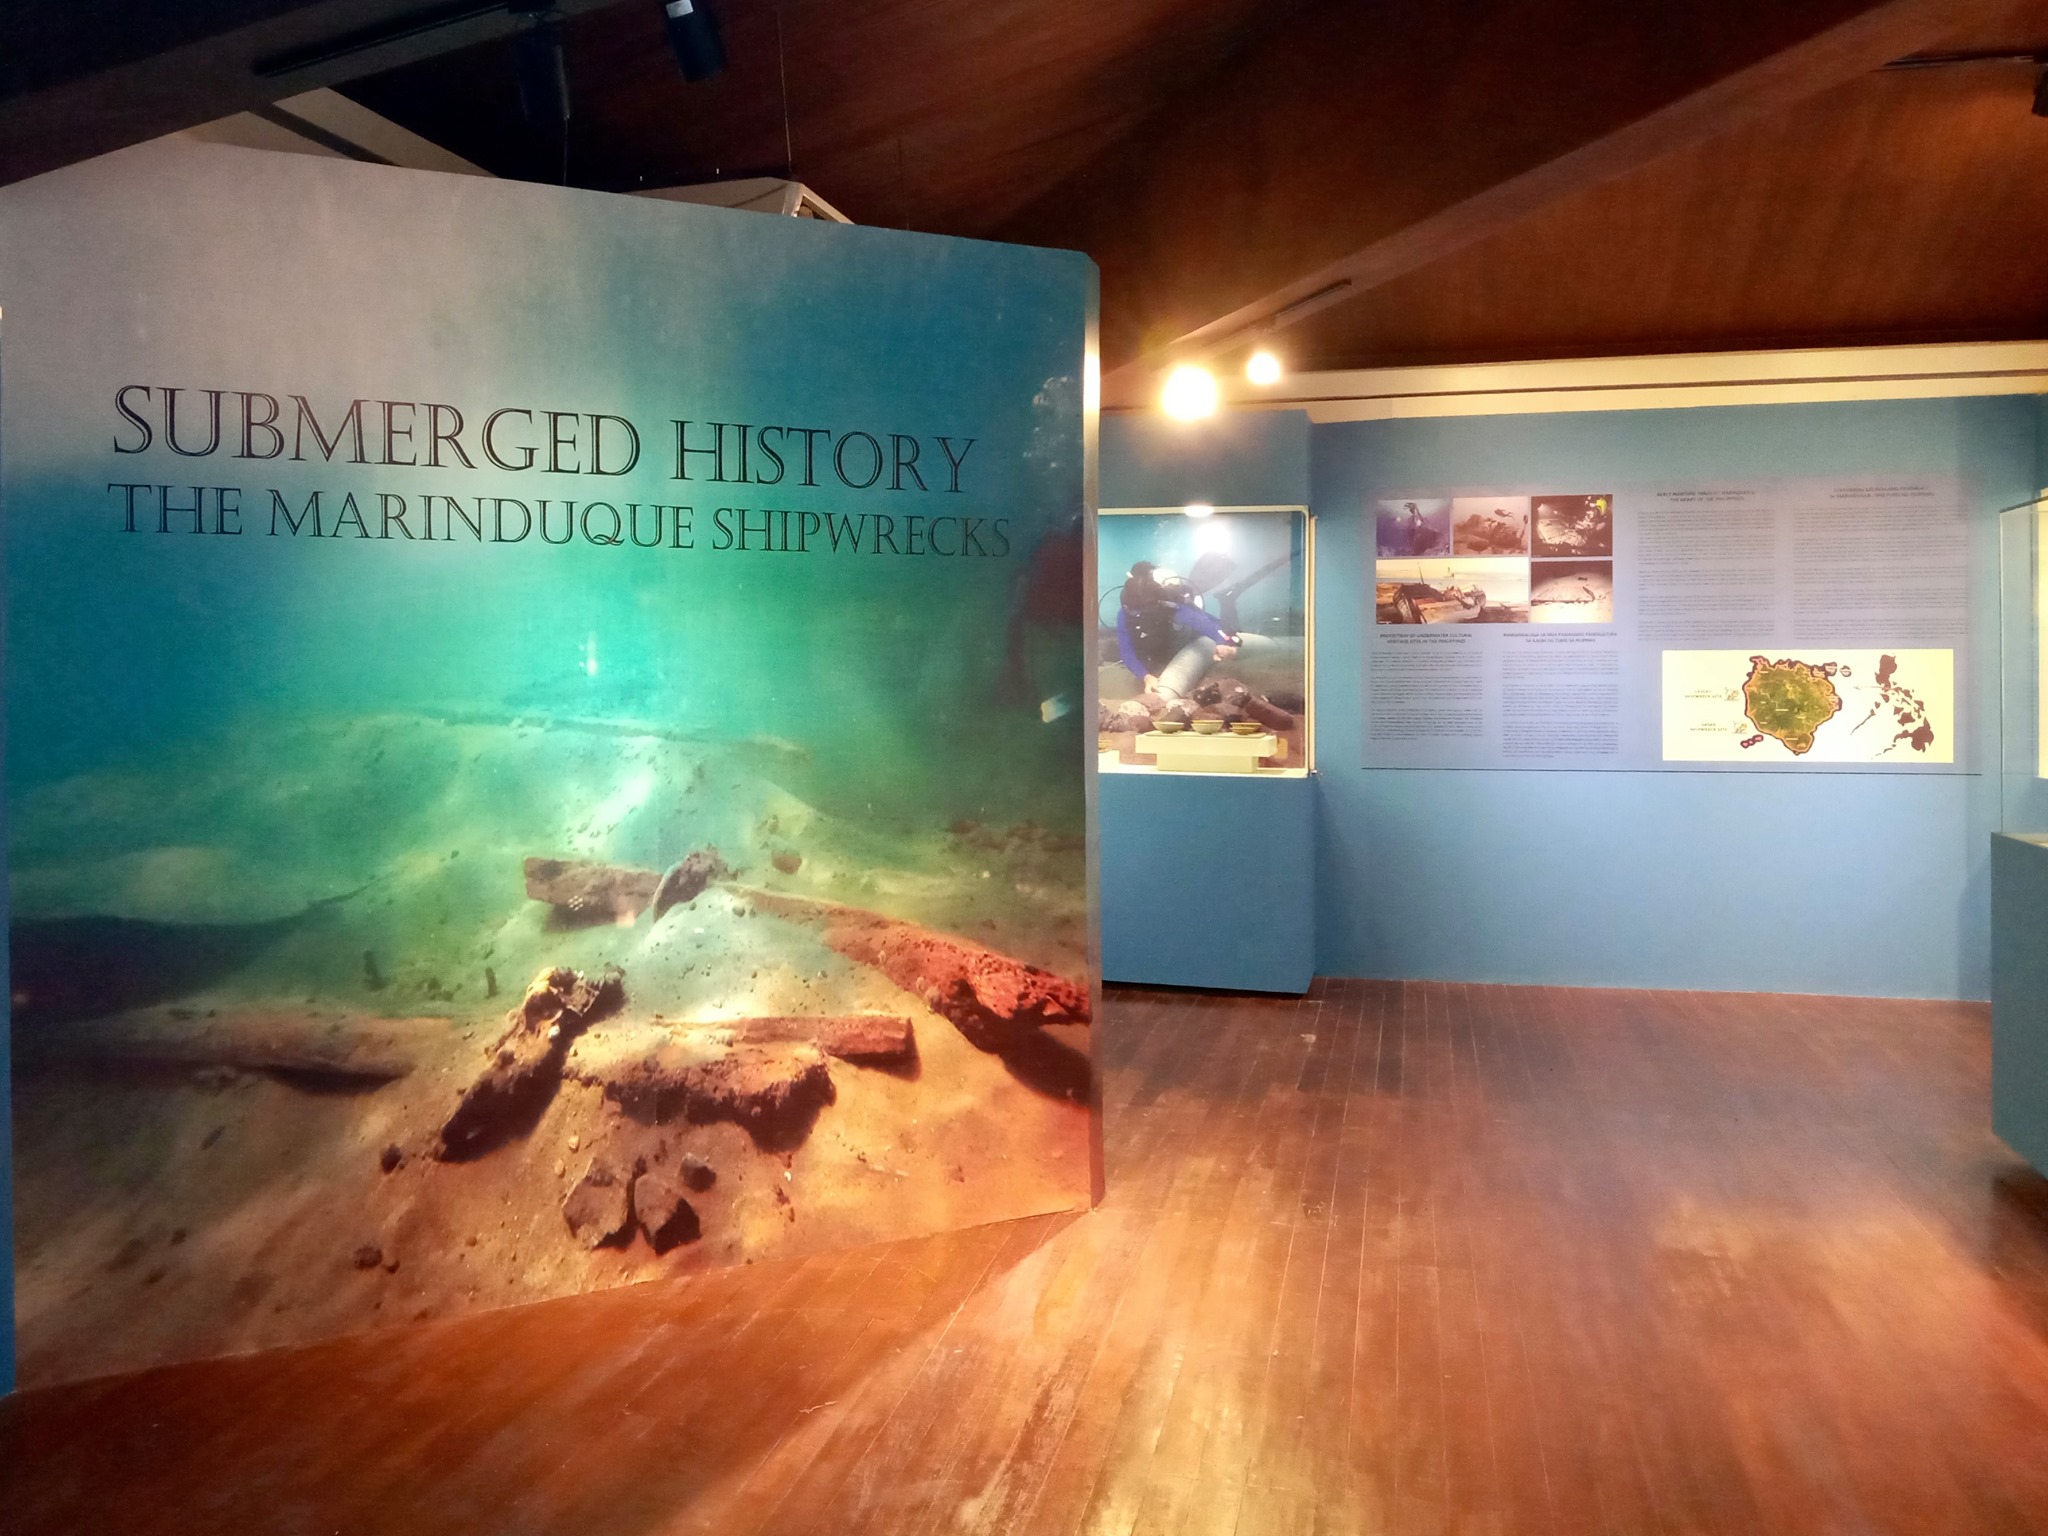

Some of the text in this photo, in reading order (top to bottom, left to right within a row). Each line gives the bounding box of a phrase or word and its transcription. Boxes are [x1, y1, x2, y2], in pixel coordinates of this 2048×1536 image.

[113, 384, 977, 494] SUBMERGED HISTORY
[107, 483, 1011, 558] THE MARINDUQUE SHIPWRECKS
